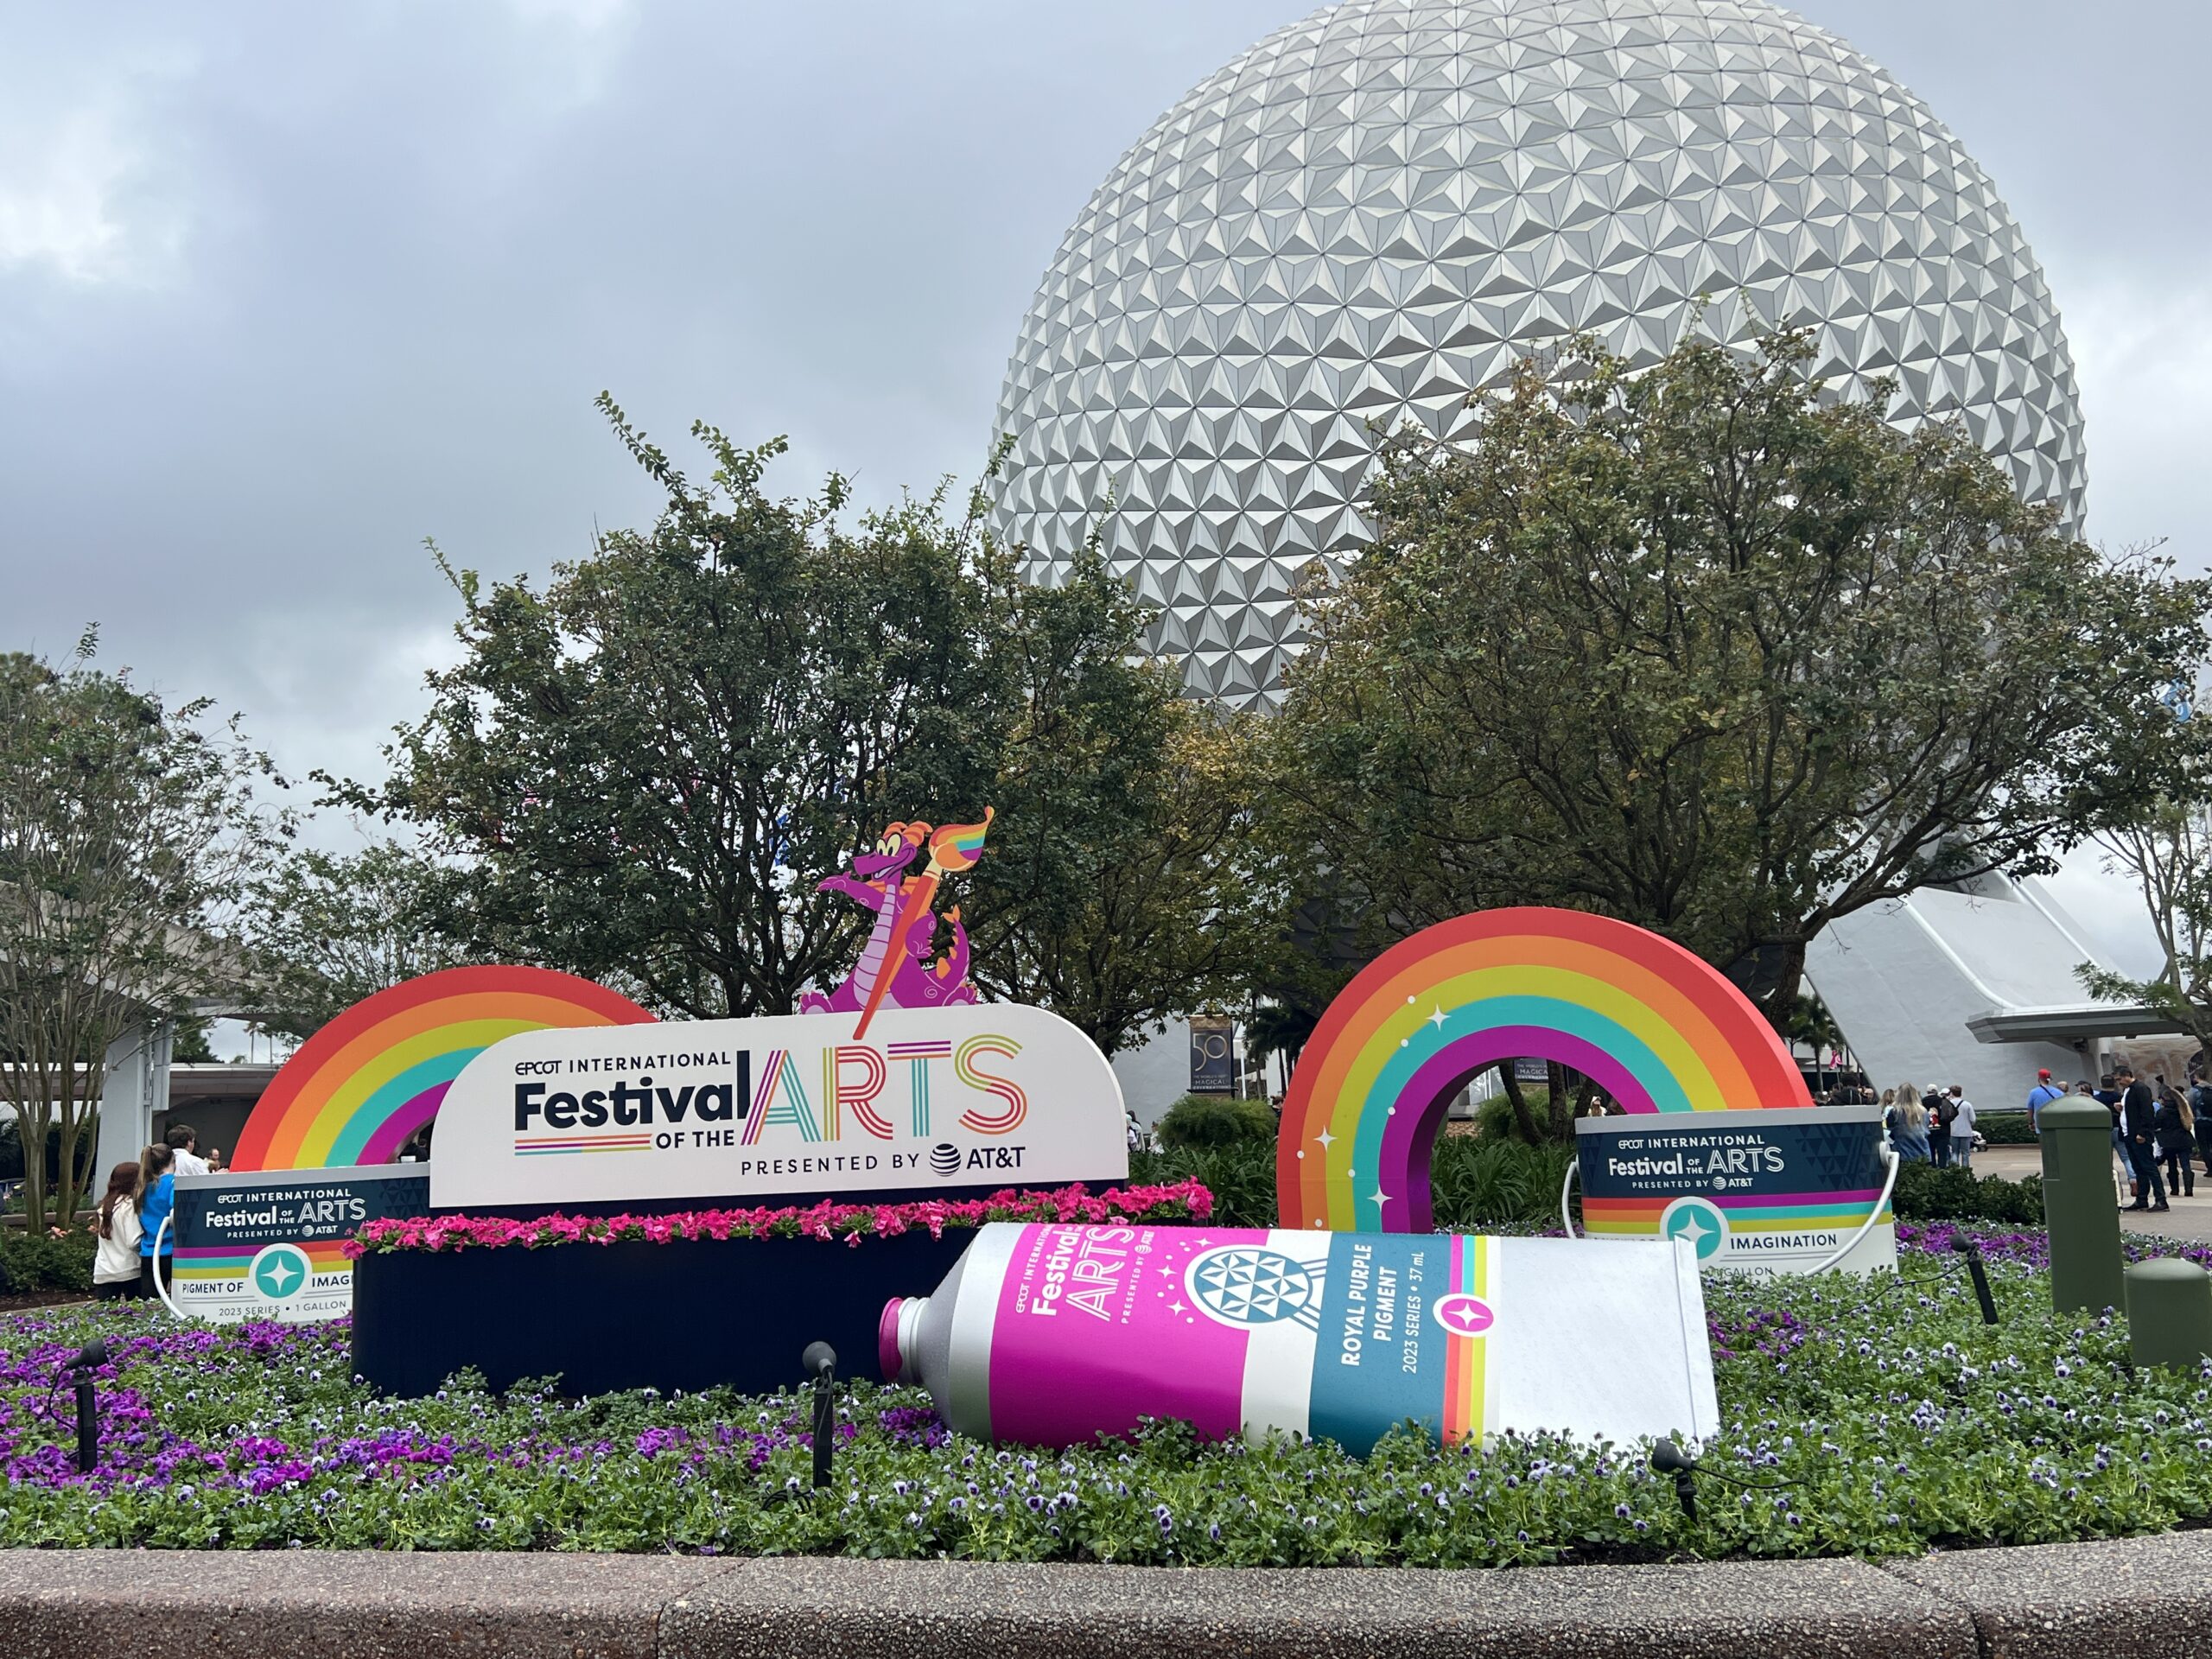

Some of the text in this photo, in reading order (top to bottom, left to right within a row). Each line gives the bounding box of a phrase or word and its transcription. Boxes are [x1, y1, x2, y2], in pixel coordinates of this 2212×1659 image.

[515, 1052, 731, 1075] EPCOT INTERNATIONAL
[1193, 1033, 1227, 1071] 50
[515, 1050, 750, 1131] Festival
[741, 1033, 1027, 1146] ARTS
[656, 1129, 734, 1149] OF THE
[1618, 1135, 1765, 1149] EPCOT INTERNATIONAL
[741, 1147, 1026, 1175] PRESENTED BY AT&T
[1608, 1153, 1683, 1176] Festival
[1707, 1147, 1784, 1174] ARTS
[218, 1189, 352, 1204] EPCOT INTERNATIONAL
[1632, 1180, 1691, 1189] PRESENTED
[1727, 1178, 1753, 1187] AT&T
[206, 1205, 276, 1228] Festival
[297, 1198, 366, 1224] ARTS
[227, 1230, 283, 1238] PRESENTED
[315, 1225, 338, 1234] AT&T
[1731, 1234, 1837, 1249] IMAGINATION
[1031, 1230, 1081, 1316] Festival
[1065, 1227, 1135, 1322] ARTS
[1725, 1267, 1772, 1278] GALLON
[182, 1283, 224, 1294] PIGMENT
[226, 1282, 244, 1293] OF
[1015, 1283, 1030, 1313] EPCOT
[1121, 1268, 1141, 1324] PRESENTED
[1135, 1256, 1145, 1266] BY
[219, 1307, 242, 1316] 2023
[245, 1306, 280, 1315] SERIES
[303, 1300, 346, 1311] GALLON
[1341, 1243, 1372, 1366] ROYAL PURPLE
[1373, 1266, 1397, 1342] PIGMENT
[1402, 1251, 1424, 1374] 2023 SERIES 37 mL
